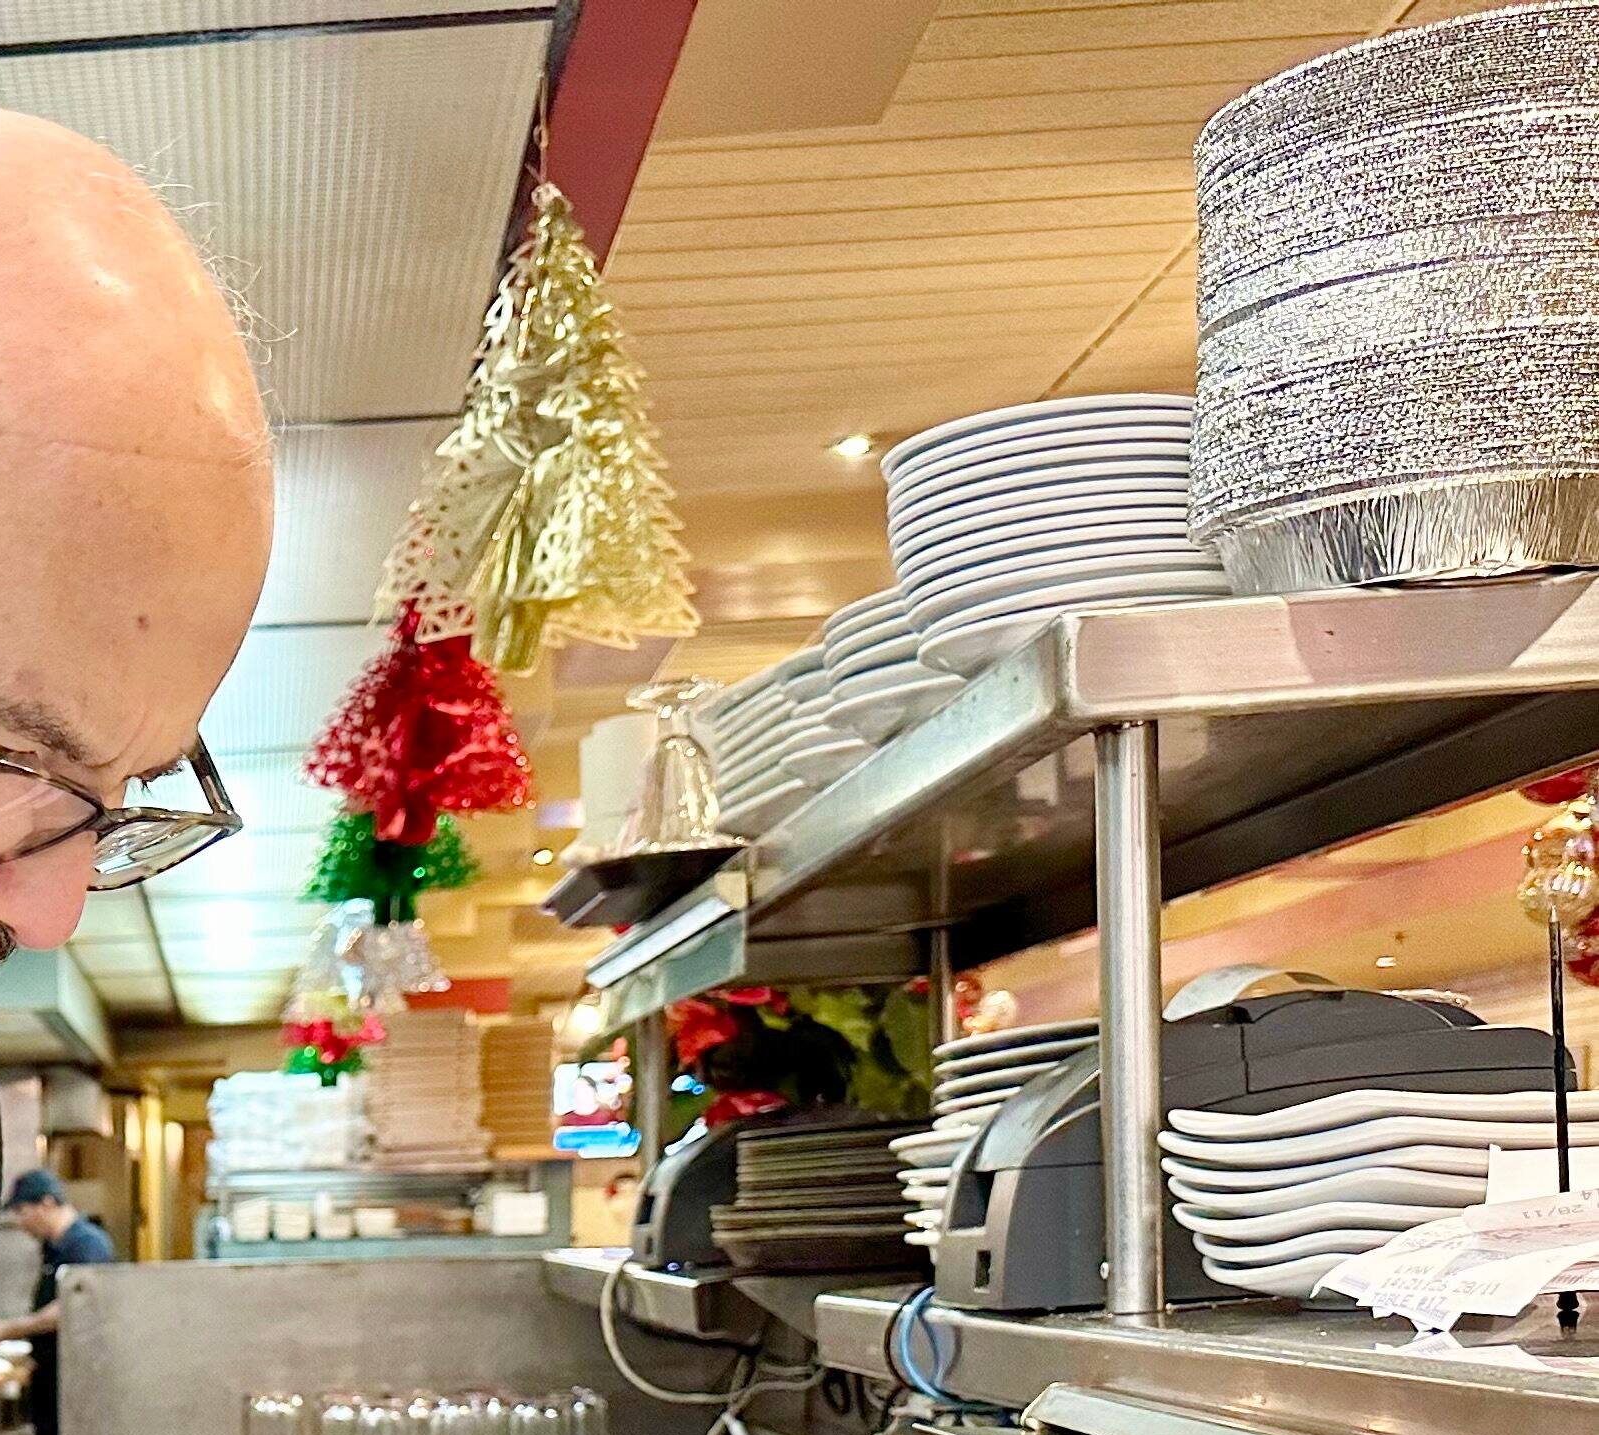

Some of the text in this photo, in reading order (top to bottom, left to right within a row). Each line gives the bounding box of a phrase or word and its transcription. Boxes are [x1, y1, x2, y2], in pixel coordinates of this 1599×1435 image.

[1522, 1204, 1584, 1219] 28/11
[1452, 1280, 1502, 1295] 28/11
[1373, 1292, 1414, 1308] TABLE
